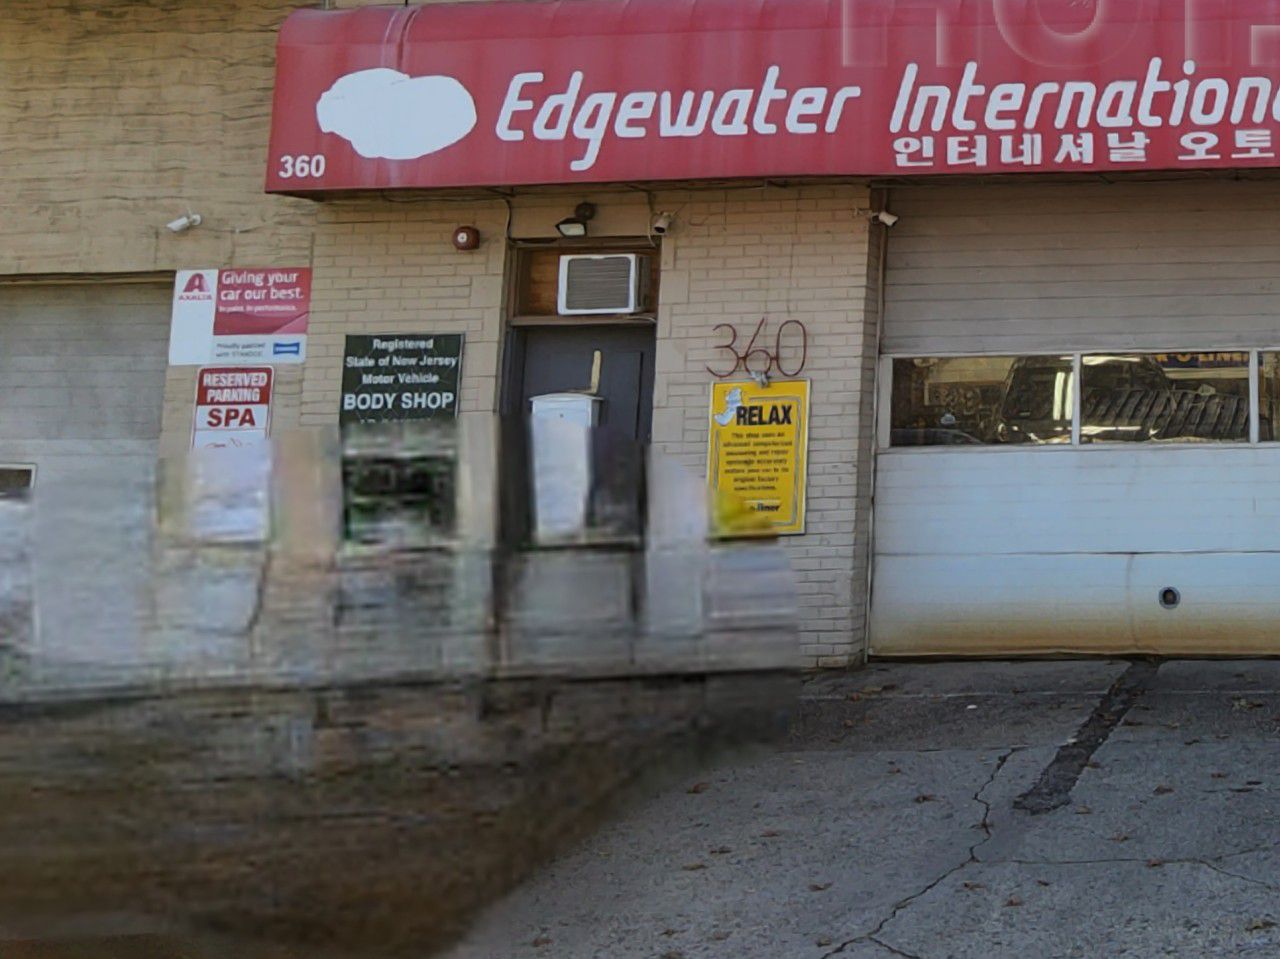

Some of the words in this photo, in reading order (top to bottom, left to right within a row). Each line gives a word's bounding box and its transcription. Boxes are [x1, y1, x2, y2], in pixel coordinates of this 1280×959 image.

[496, 65, 861, 171] Edgewater
[278, 155, 326, 178] 360
[222, 271, 265, 287] Giving
[267, 271, 299, 286] your
[220, 289, 242, 301] car
[244, 288, 268, 300] our
[270, 285, 304, 300] best.
[372, 338, 434, 352] Registered
[705, 317, 807, 378] 360
[346, 356, 375, 368] State
[378, 356, 389, 367] of
[392, 356, 417, 366] New
[419, 355, 458, 368] Jersey
[203, 372, 268, 387] RESERVED
[362, 374, 395, 384] Motor
[398, 372, 440, 384] Vehicle
[206, 388, 260, 403] PARKING
[343, 393, 396, 410] BODY
[401, 392, 455, 409] SHOP
[207, 408, 256, 428] SPA
[736, 404, 792, 426] RELAX
